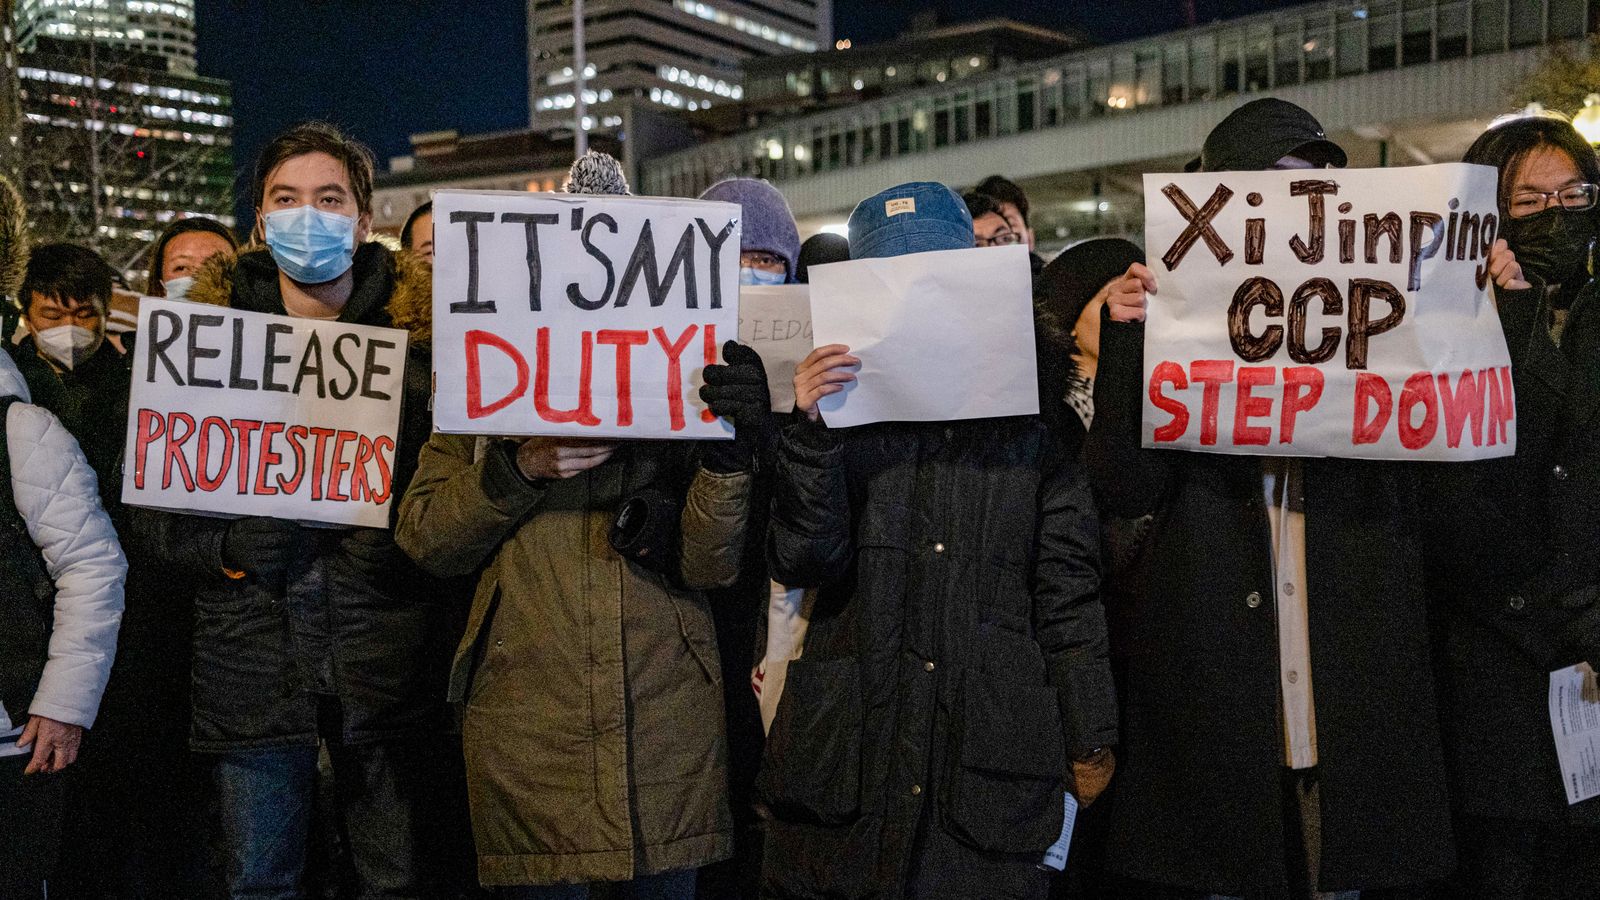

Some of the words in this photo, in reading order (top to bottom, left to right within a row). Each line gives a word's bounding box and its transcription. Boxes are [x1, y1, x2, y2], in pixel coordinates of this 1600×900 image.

[1161, 182, 1266, 272] Xi
[1288, 179, 1498, 291] Jinping
[146, 309, 395, 401] RELEASE
[1227, 276, 1406, 370] CCP
[464, 323, 718, 431] DUTY!
[1149, 360, 1325, 446] STEP
[1352, 365, 1514, 450] DOWN
[134, 408, 394, 505] PROTESTERS
